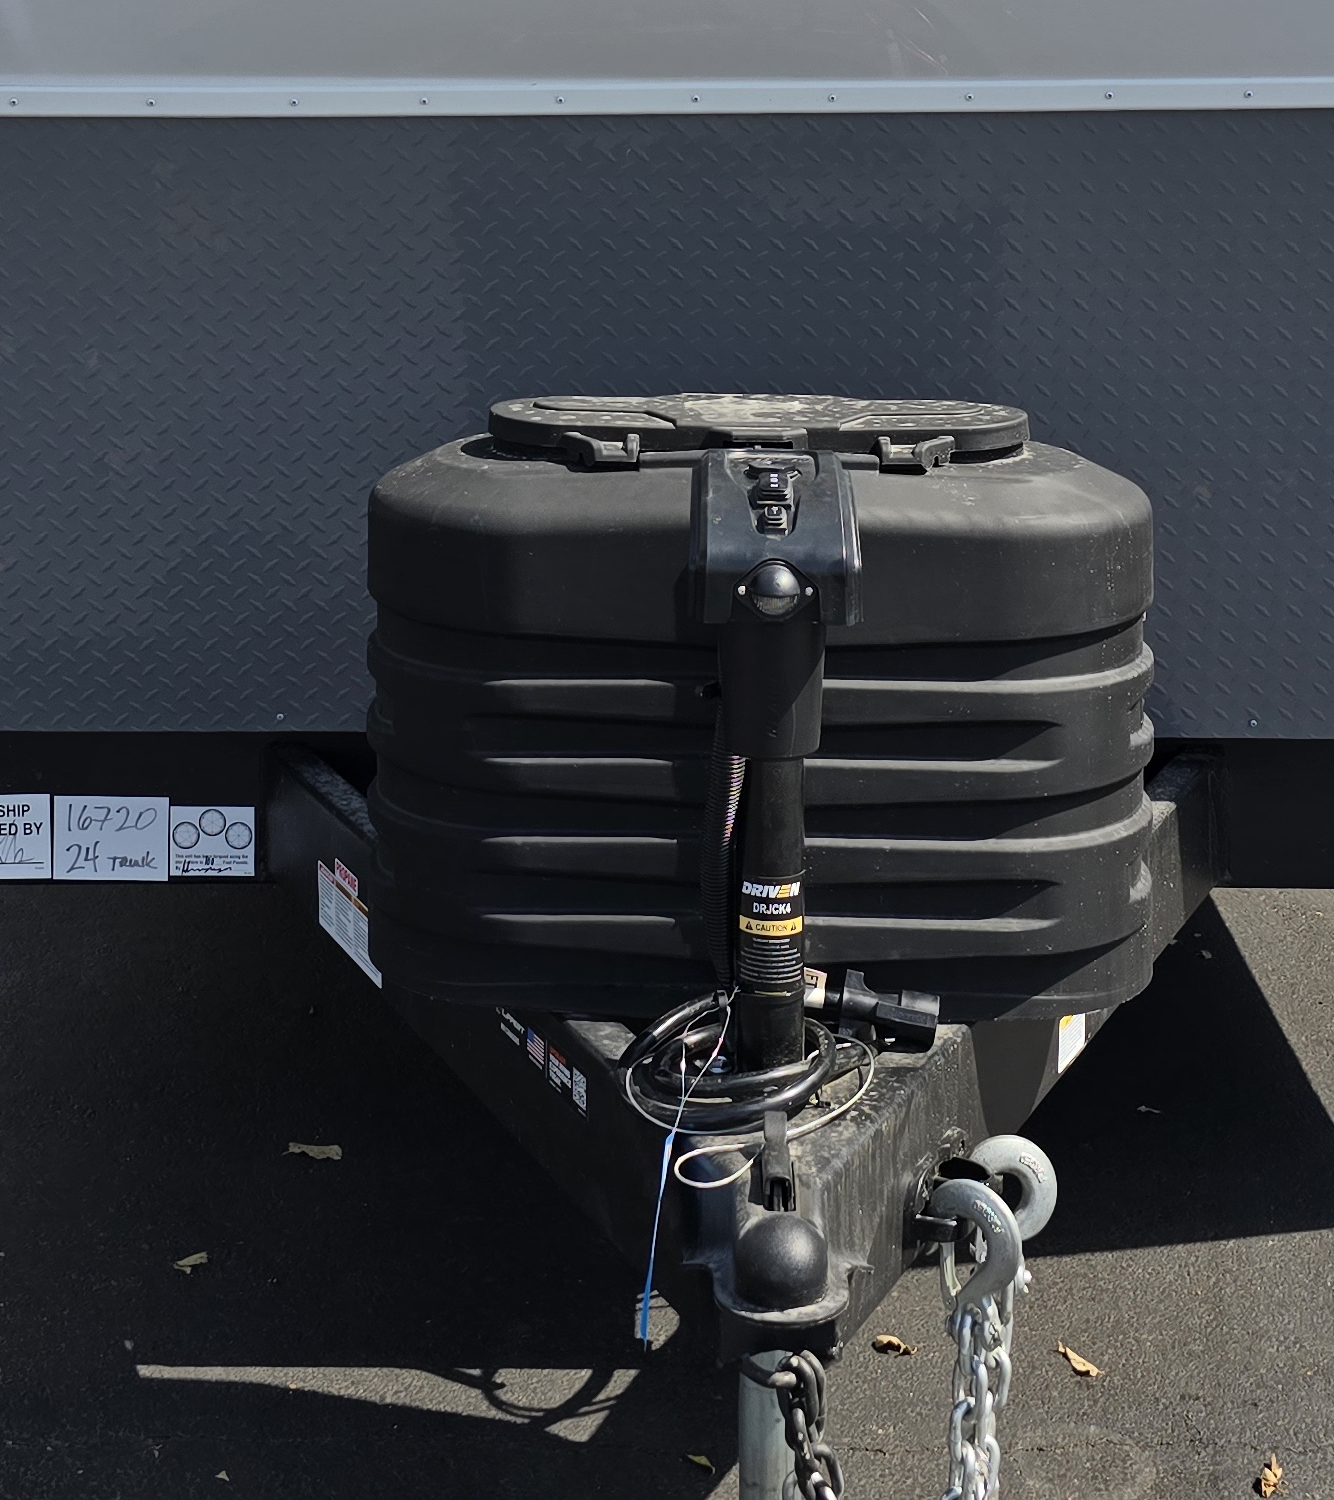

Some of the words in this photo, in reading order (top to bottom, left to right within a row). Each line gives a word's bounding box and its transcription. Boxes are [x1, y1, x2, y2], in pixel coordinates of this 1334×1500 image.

[68, 803, 157, 832] 16720
[23, 821, 44, 836] BY
[65, 840, 101, 874] 24
[741, 881, 801, 899] DRIVEN
[752, 902, 792, 915] DRJCK4
[755, 922, 788, 933] CAUTION
